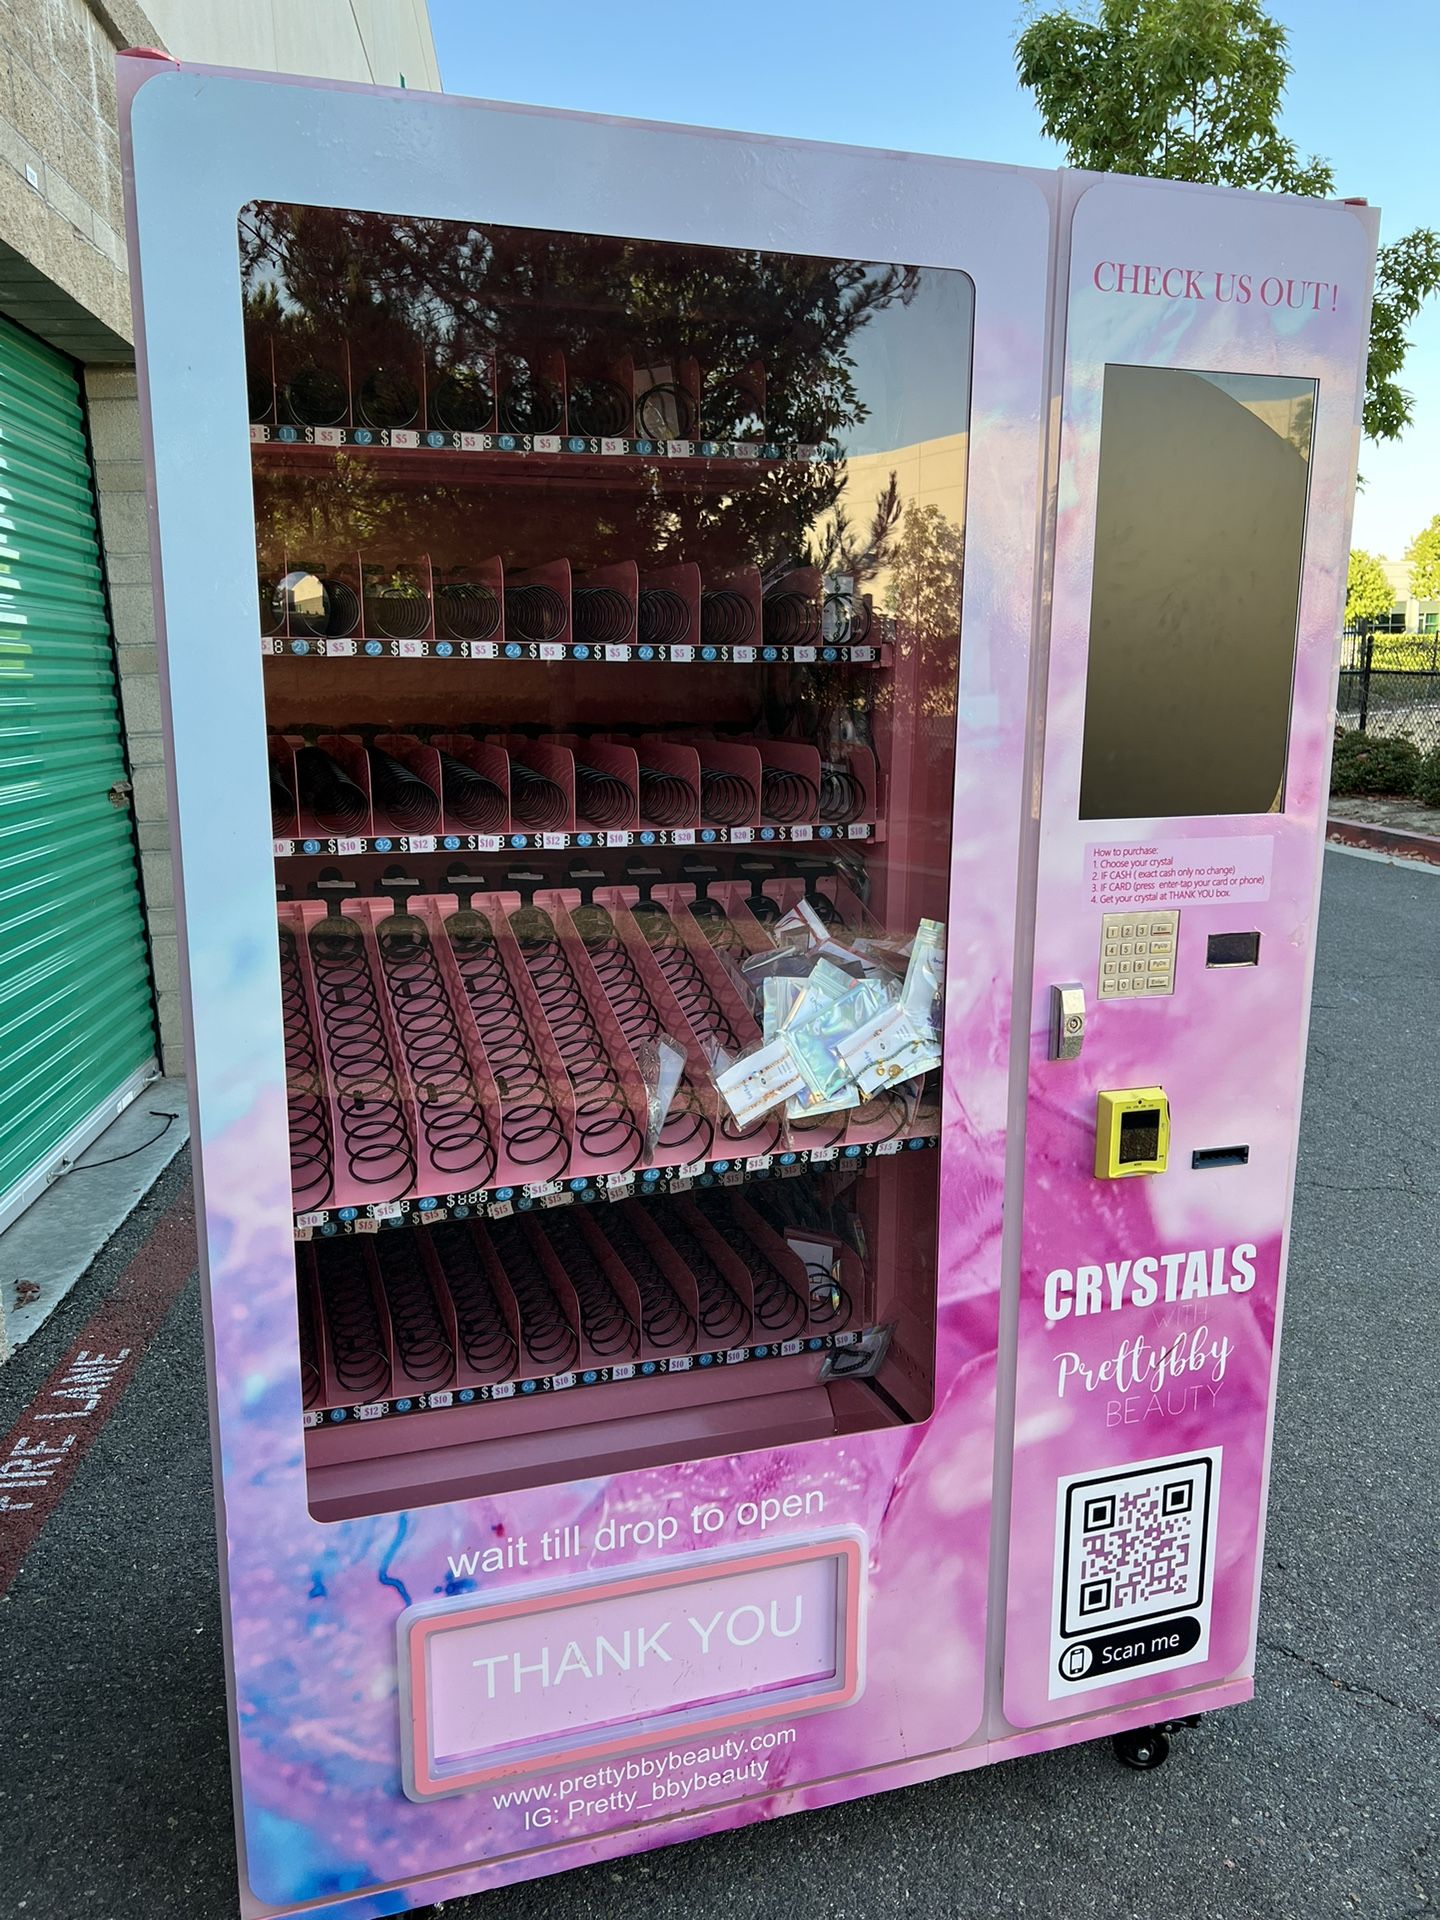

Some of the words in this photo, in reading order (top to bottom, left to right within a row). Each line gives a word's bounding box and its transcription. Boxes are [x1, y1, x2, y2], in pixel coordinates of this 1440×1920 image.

[1093, 261, 1205, 300] CHECK
[1214, 272, 1251, 304] US
[1260, 277, 1338, 311] OUT!
[283, 429, 295, 439] 11
[320, 432, 333, 442] $5
[357, 431, 371, 442] 12
[395, 434, 407, 444] $5
[430, 434, 443, 444] 13
[464, 438, 476, 447] $5
[540, 438, 551, 448] $5
[571, 439, 583, 449] 15
[605, 441, 616, 450] $5
[638, 442, 650, 452] 16
[294, 643, 308, 653] 21
[332, 642, 345, 653] $5
[367, 644, 381, 653] 22
[404, 643, 416, 653] $5
[438, 644, 451, 654] 23
[475, 645, 486, 655] $5
[507, 647, 519, 656] 24
[543, 647, 555, 656] $5
[575, 647, 587, 657] 25
[609, 647, 620, 658] $5
[640, 648, 652, 658] 26
[673, 649, 685, 658] $5
[703, 649, 715, 659] 27
[737, 650, 747, 659] $5
[764, 649, 776, 659] 28
[799, 649, 809, 658] $5
[823, 649, 836, 659] 29
[854, 649, 865, 658] $5
[305, 842, 318, 852] 31
[340, 841, 356, 851] $10
[376, 840, 390, 850] 32
[412, 839, 428, 849] $12
[445, 838, 459, 848] 33
[479, 838, 494, 848] $10
[513, 837, 526, 846] 34
[545, 836, 560, 845] $12
[579, 835, 591, 845] 35
[609, 833, 623, 844] $10
[642, 834, 654, 843] 36
[677, 833, 692, 842] $20
[703, 831, 715, 840] 37
[733, 831, 747, 840] $20
[762, 829, 774, 838] 38
[794, 828, 808, 837] $10
[820, 828, 832, 837] 39
[850, 827, 863, 836] $10
[1123, 847, 1158, 858] purchase:
[1100, 860, 1129, 868] Choose
[1131, 860, 1147, 869] your
[1150, 857, 1173, 867] crystal
[1110, 871, 1131, 879] CASH
[1160, 869, 1176, 877] cash
[1178, 867, 1193, 878] only
[1207, 866, 1235, 876] change)
[1100, 895, 1113, 903] Get
[1116, 896, 1132, 904] your
[1134, 892, 1158, 903] crystal
[1169, 890, 1196, 899] THANK
[1198, 890, 1214, 898] YOU
[1101, 883, 1107, 891] IF
[1109, 882, 1131, 891] CARD
[1134, 882, 1155, 891] (press
[1194, 880, 1210, 889] your
[1212, 878, 1228, 886] card
[1239, 875, 1264, 887] phone)
[300, 1216, 318, 1226] $10
[341, 1209, 356, 1218] 41
[377, 1206, 394, 1216] $15
[421, 1199, 437, 1208] 42
[498, 1190, 512, 1198] 43
[531, 1185, 548, 1195] $15
[572, 1180, 587, 1189] 44
[611, 1174, 627, 1185] $15
[645, 1170, 659, 1179] 45
[682, 1163, 698, 1174] $15
[714, 1162, 728, 1171] 46
[748, 1159, 763, 1168] $15
[781, 1155, 795, 1163] 47
[813, 1150, 828, 1159] $15
[878, 1143, 892, 1151] $15
[323, 1225, 335, 1234] 51
[358, 1221, 373, 1230] $15
[423, 1211, 439, 1221] $15
[494, 1205, 508, 1216] $15
[548, 1195, 561, 1205] $15
[610, 1188, 623, 1198] $15
[672, 1180, 685, 1191] $15
[727, 1175, 740, 1183] $15
[1044, 1243, 1257, 1321] CRYSTALS
[1152, 1303, 1208, 1328] WITH
[333, 1410, 345, 1419] 61
[365, 1406, 379, 1416] $12
[398, 1400, 409, 1410] 62
[434, 1396, 447, 1405] $10
[461, 1391, 473, 1401] 63
[496, 1386, 509, 1395] $10
[555, 1376, 569, 1386] $10
[615, 1367, 628, 1377] $10
[672, 1360, 684, 1369] $10
[728, 1352, 740, 1361] $10
[784, 1343, 796, 1352] $10
[836, 1335, 848, 1345] $10
[1053, 1326, 1234, 1398] Prettybby
[34, 1349, 130, 1421] LANE
[1107, 1382, 1224, 1427] BEAUTY
[447, 1537, 528, 1578] wait
[541, 1525, 580, 1560] till
[594, 1516, 678, 1551] drop
[691, 1504, 725, 1534] to
[737, 1489, 825, 1527] open
[472, 1621, 673, 1699] THANK
[687, 1595, 802, 1655] YOU
[1102, 1642, 1145, 1664] Scan
[1151, 1634, 1179, 1652] me
[493, 1728, 797, 1811] www.prettybbybeauty.com
[524, 1806, 559, 1830] IG:
